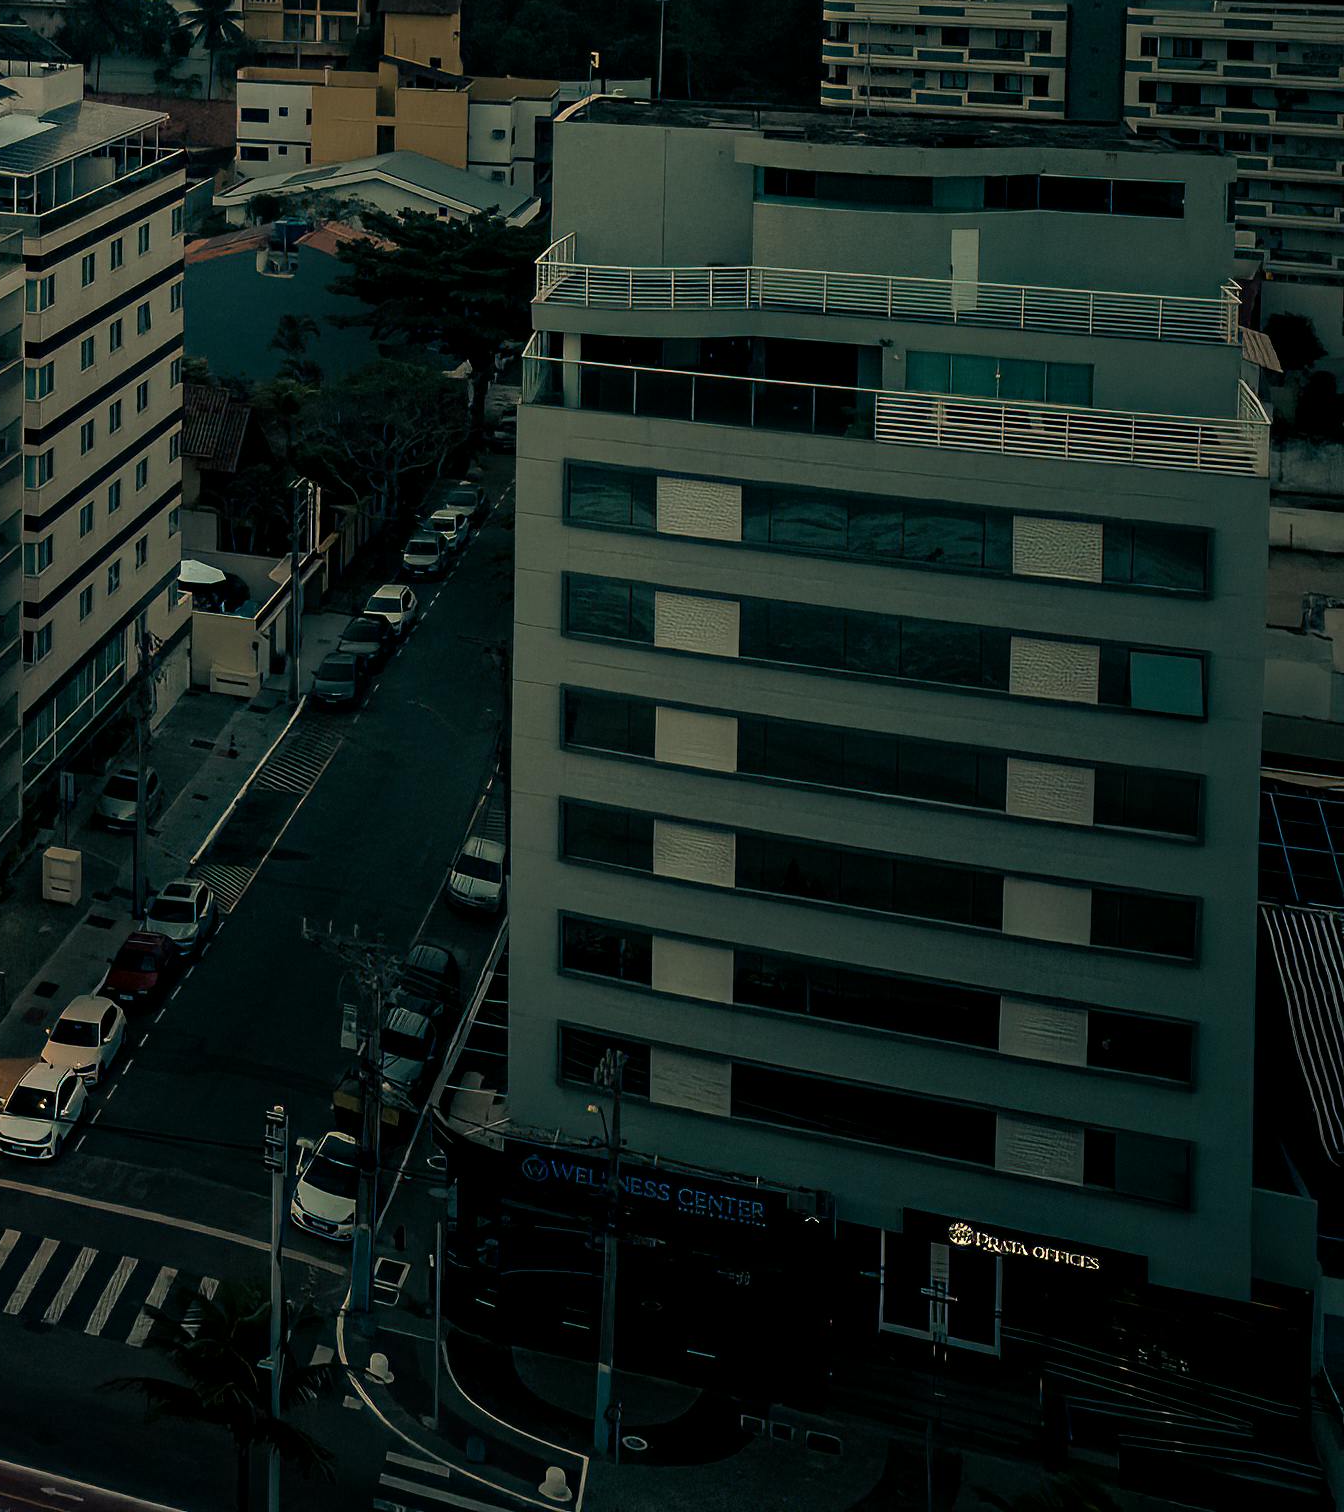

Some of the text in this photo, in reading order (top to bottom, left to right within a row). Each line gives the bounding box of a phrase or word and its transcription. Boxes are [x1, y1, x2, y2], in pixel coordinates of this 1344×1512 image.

[678, 1188, 766, 1218] CENTER
[976, 1232, 1100, 1270] PRATA OFFICES
